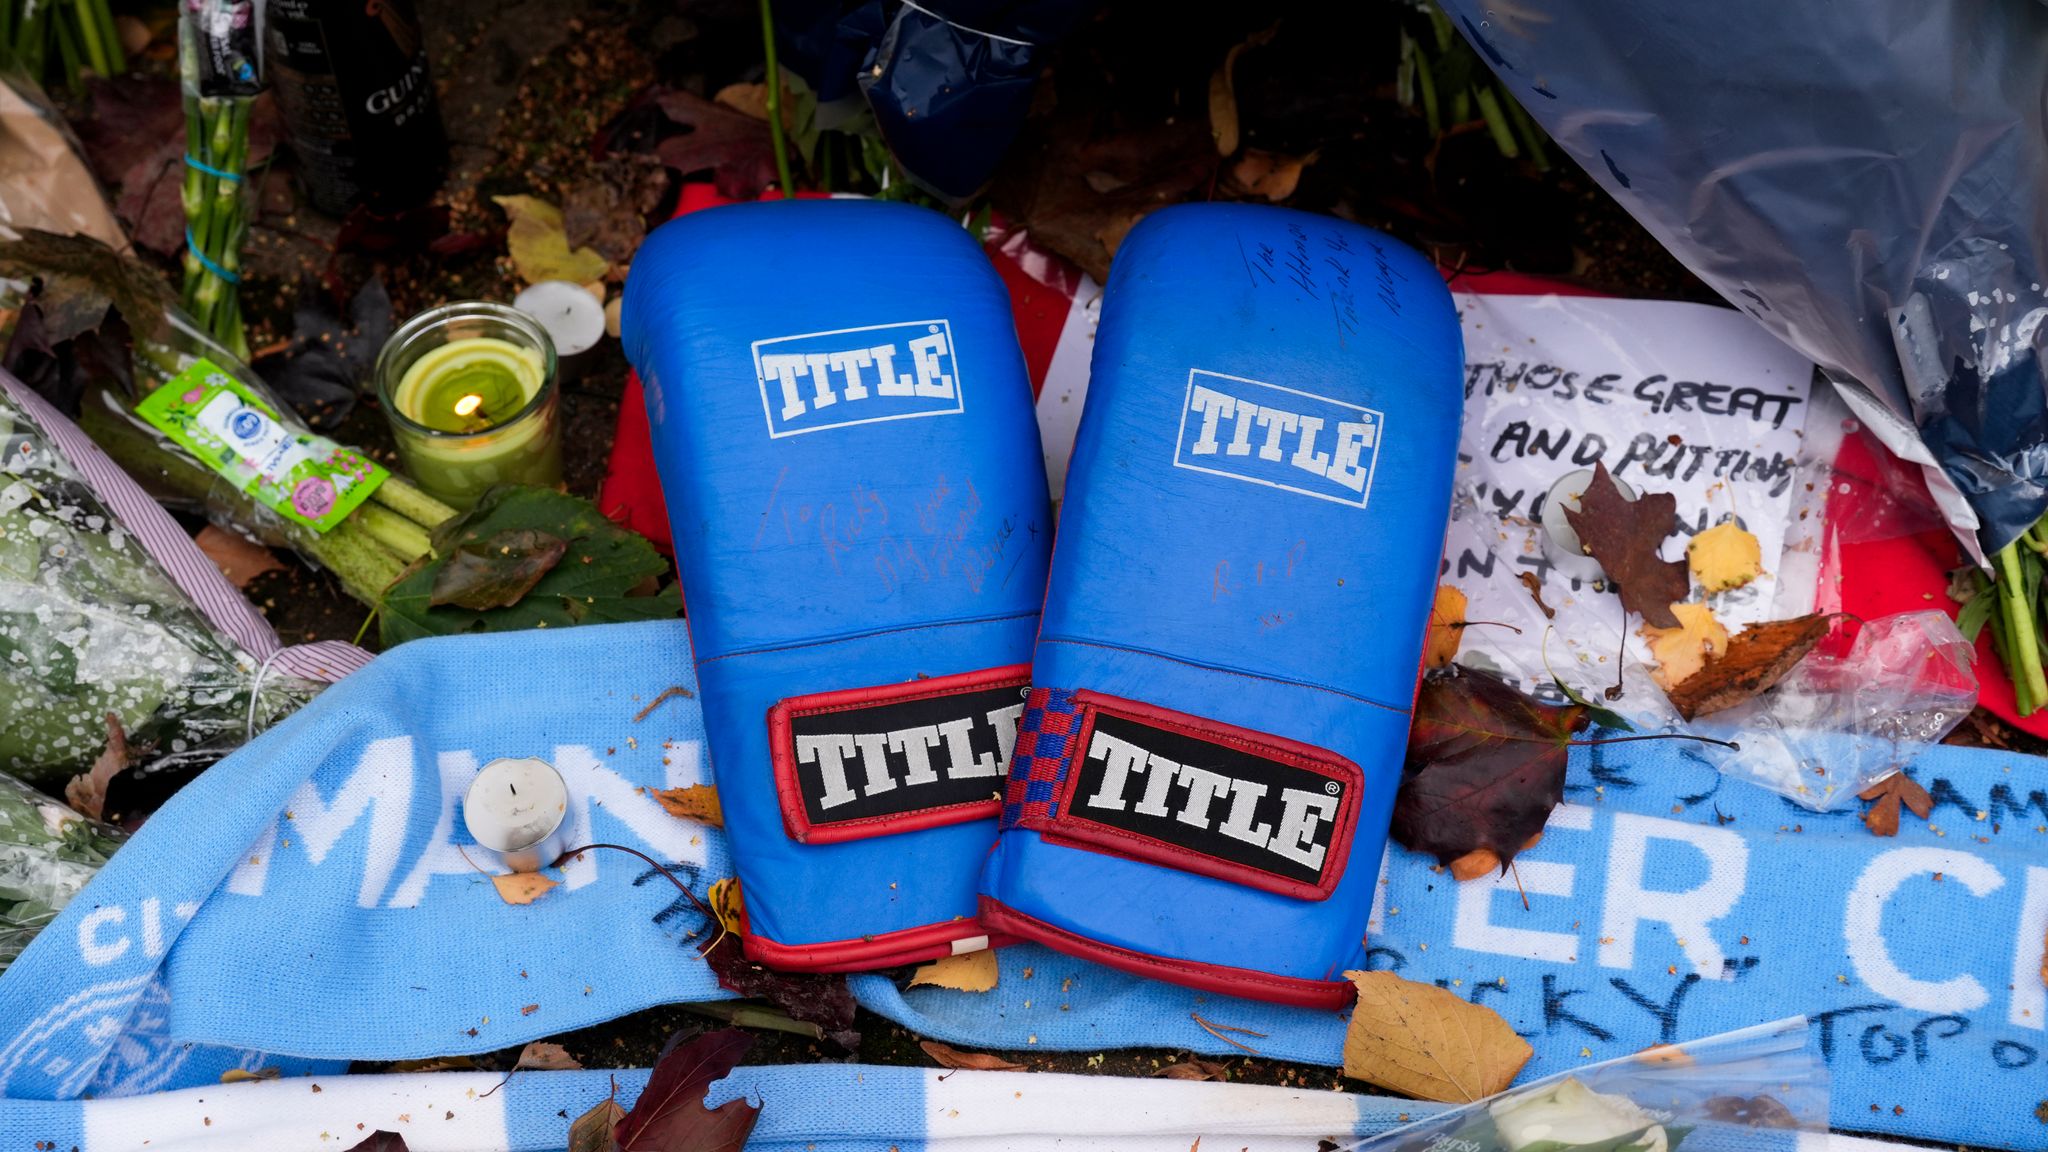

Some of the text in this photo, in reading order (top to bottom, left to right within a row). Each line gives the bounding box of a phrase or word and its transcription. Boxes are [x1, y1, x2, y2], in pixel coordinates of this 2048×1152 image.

[762, 331, 955, 421] TITLE
[1634, 374, 1804, 430] GREAT
[1191, 385, 1377, 493] TITLE
[1491, 420, 1607, 466] AND
[1086, 730, 1340, 872] TITLE
[78, 896, 203, 966] CI
[1807, 1003, 1971, 1066] TOP
